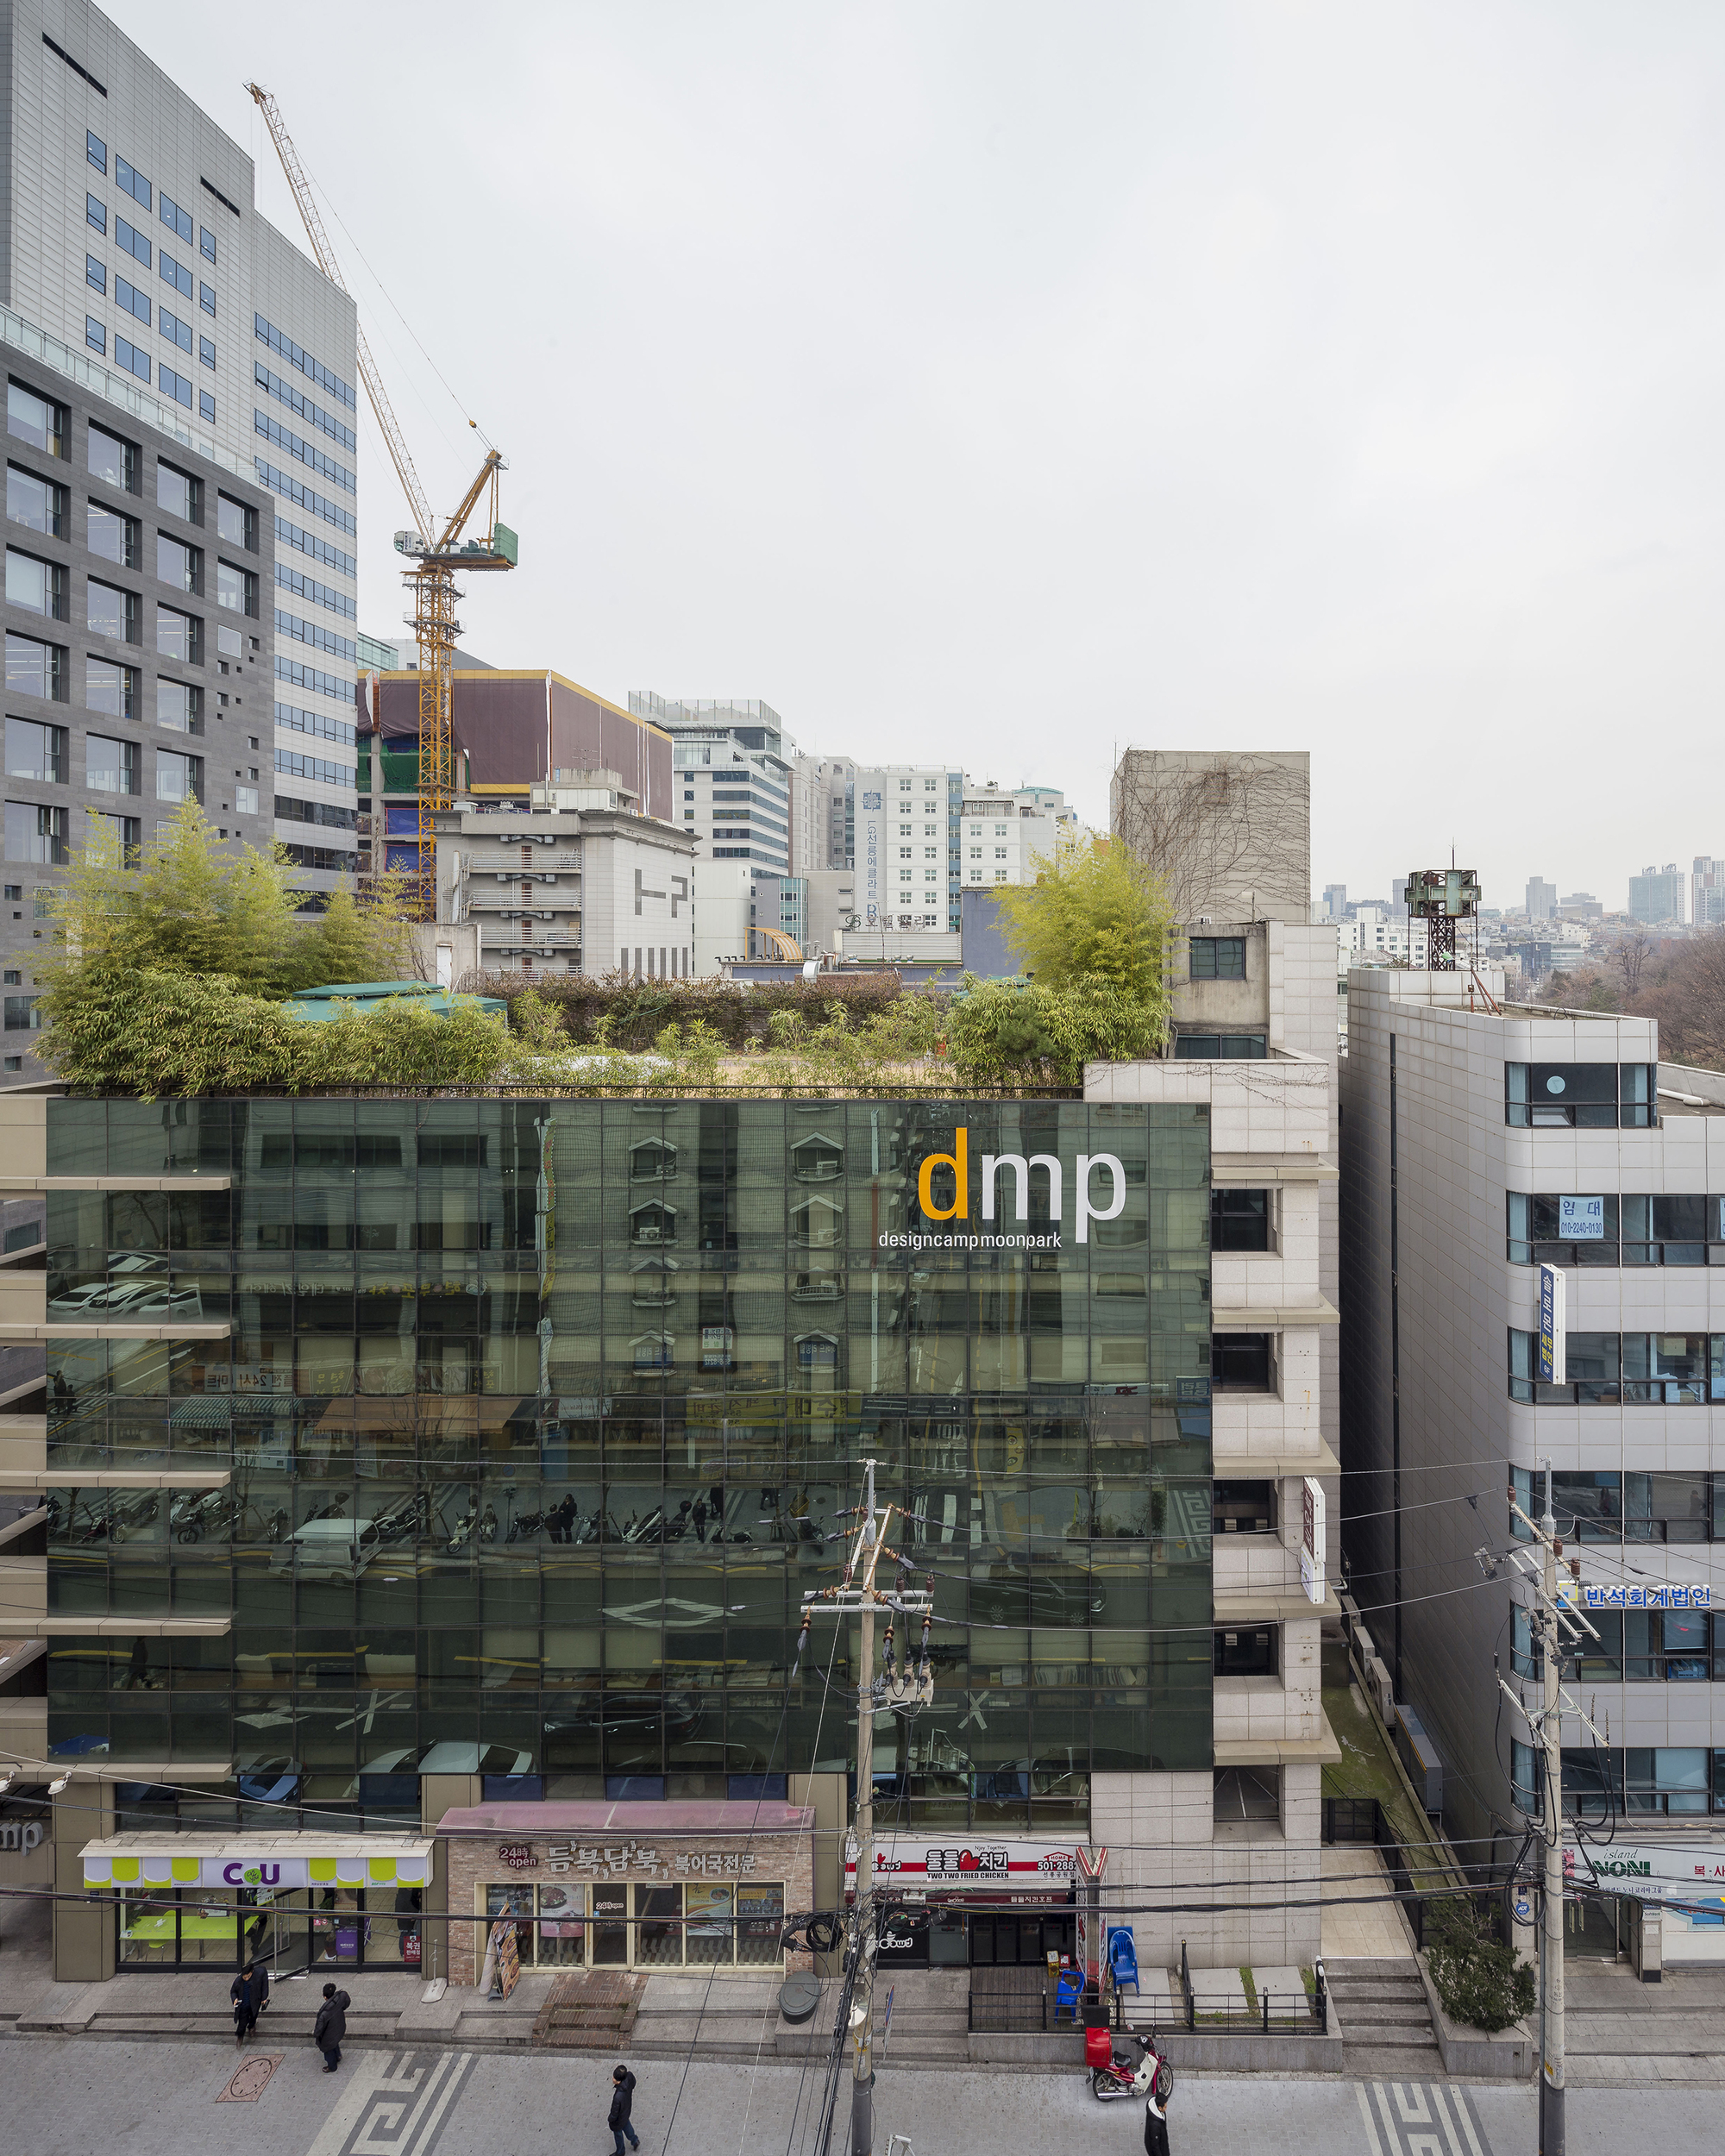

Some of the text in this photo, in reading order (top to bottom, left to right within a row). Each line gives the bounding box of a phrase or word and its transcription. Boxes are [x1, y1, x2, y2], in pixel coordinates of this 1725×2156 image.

[918, 1127, 1126, 1244] dmp
[1563, 1200, 1601, 1216] 임대
[1561, 1222, 1603, 1234] 010-2240-0130
[1542, 1275, 1552, 1333] 솔로몬
[1585, 1585, 1711, 1608] 반석회계법인
[926, 1850, 959, 1871] 둘둘
[978, 1851, 1008, 1871] 치킨
[1603, 1848, 1639, 1859] island
[509, 1857, 536, 1869] open
[674, 1853, 756, 1875] 북어국전문
[1592, 1860, 1651, 1877] NONI
[223, 1862, 281, 1885] CU
[980, 1871, 1009, 1880] CHICKEN
[406, 1941, 421, 1950] 복권
